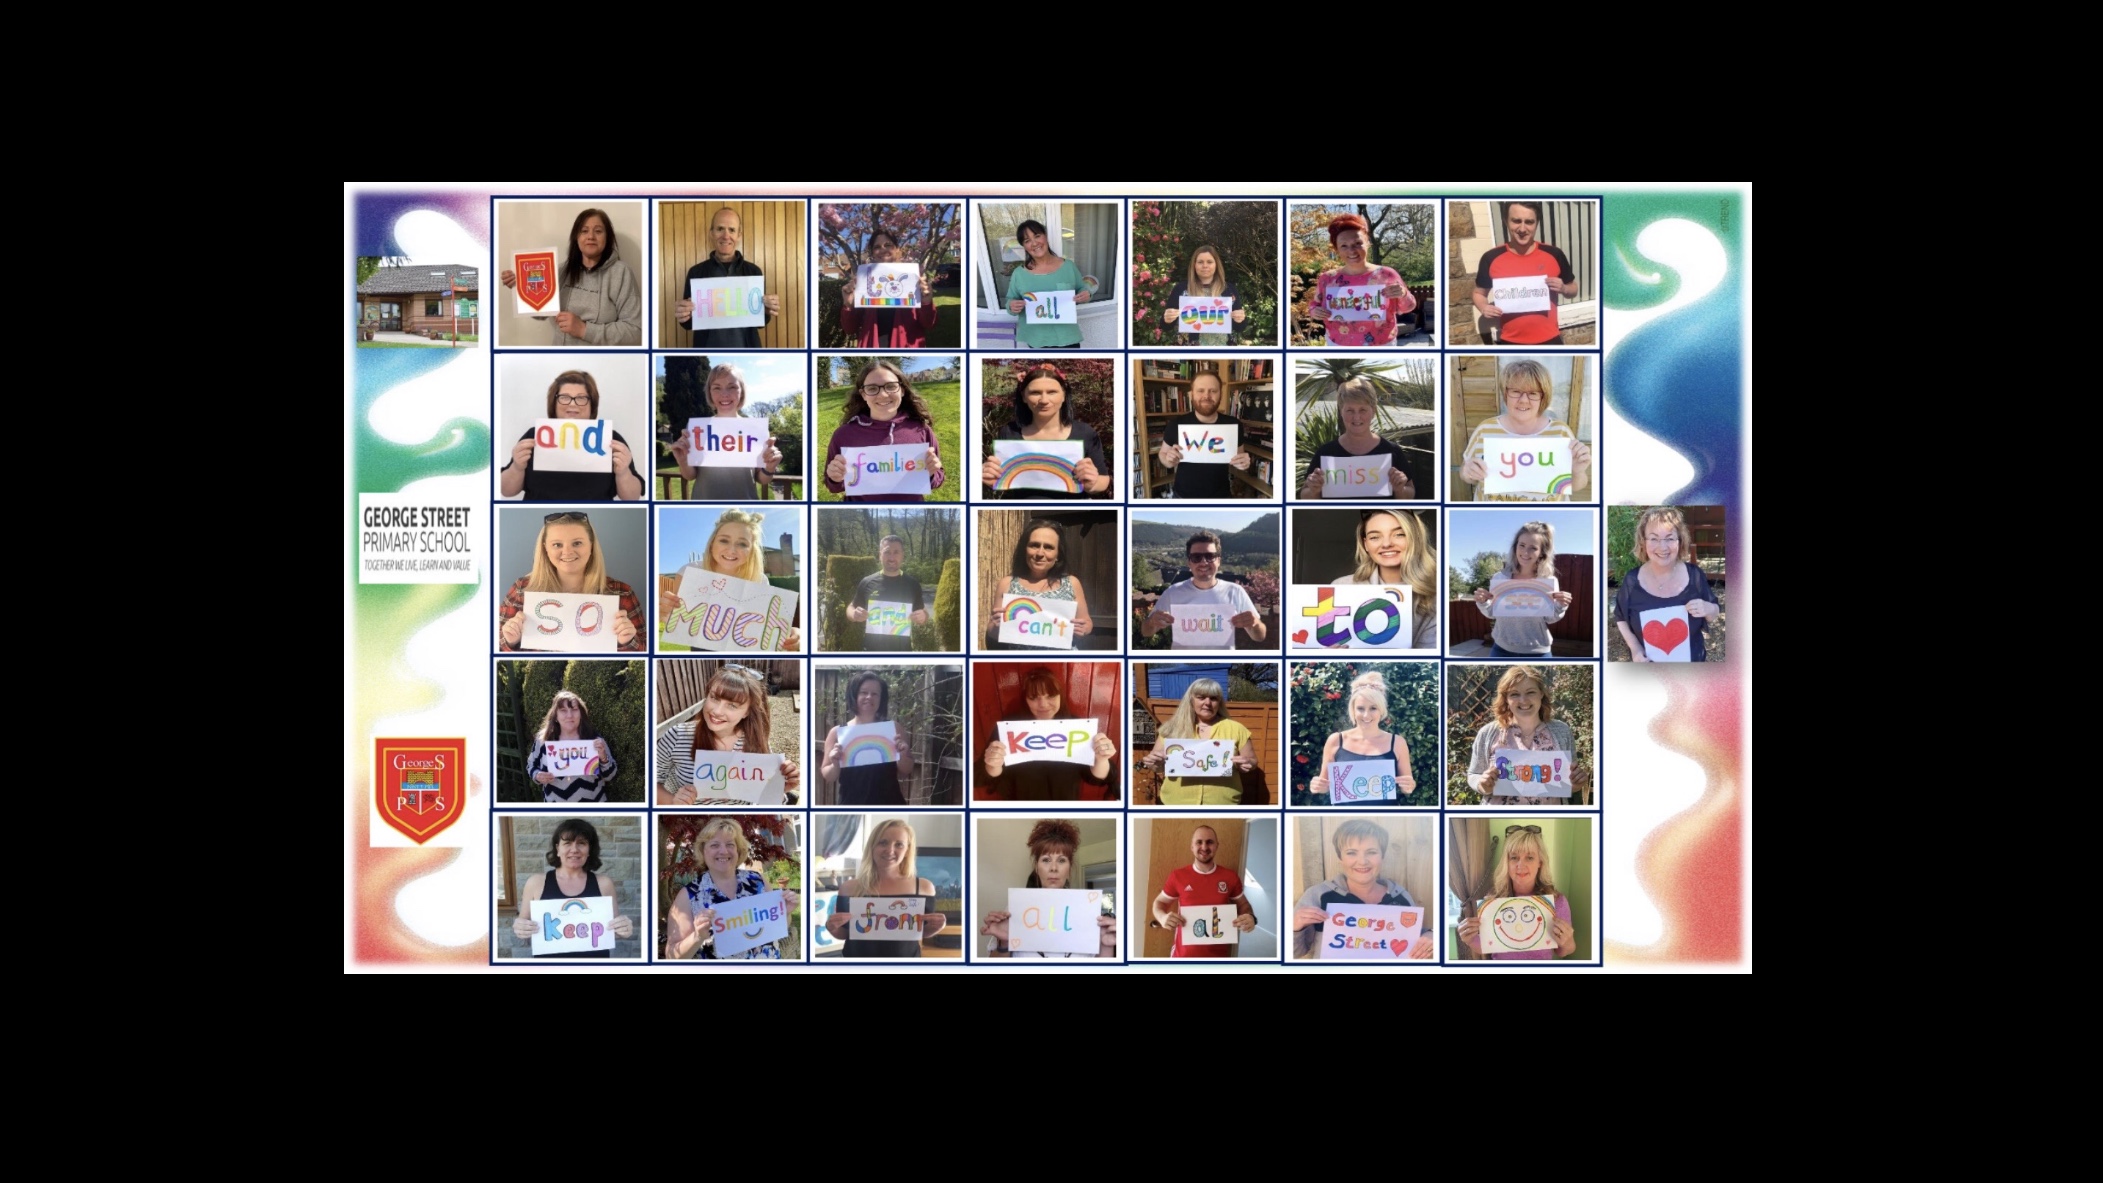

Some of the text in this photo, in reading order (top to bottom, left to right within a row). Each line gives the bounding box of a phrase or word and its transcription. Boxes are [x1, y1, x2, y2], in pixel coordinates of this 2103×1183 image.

[696, 287, 762, 318] HELLO
[1035, 296, 1060, 320] all
[1181, 305, 1229, 326] our
[536, 419, 606, 456] and
[691, 424, 758, 453] their
[1325, 464, 1380, 485] miss
[1499, 451, 1554, 479] you
[868, 604, 908, 626] and
[1018, 617, 1067, 637] can't
[1181, 613, 1224, 632] wait
[1302, 587, 1400, 646] to
[554, 745, 589, 770] you
[696, 759, 765, 790] again
[714, 901, 784, 933] Smiling!
[855, 902, 922, 934] from
[1022, 905, 1073, 932] all
[1192, 906, 1224, 939] at
[1331, 912, 1396, 932] George
[1328, 933, 1388, 950] Street
